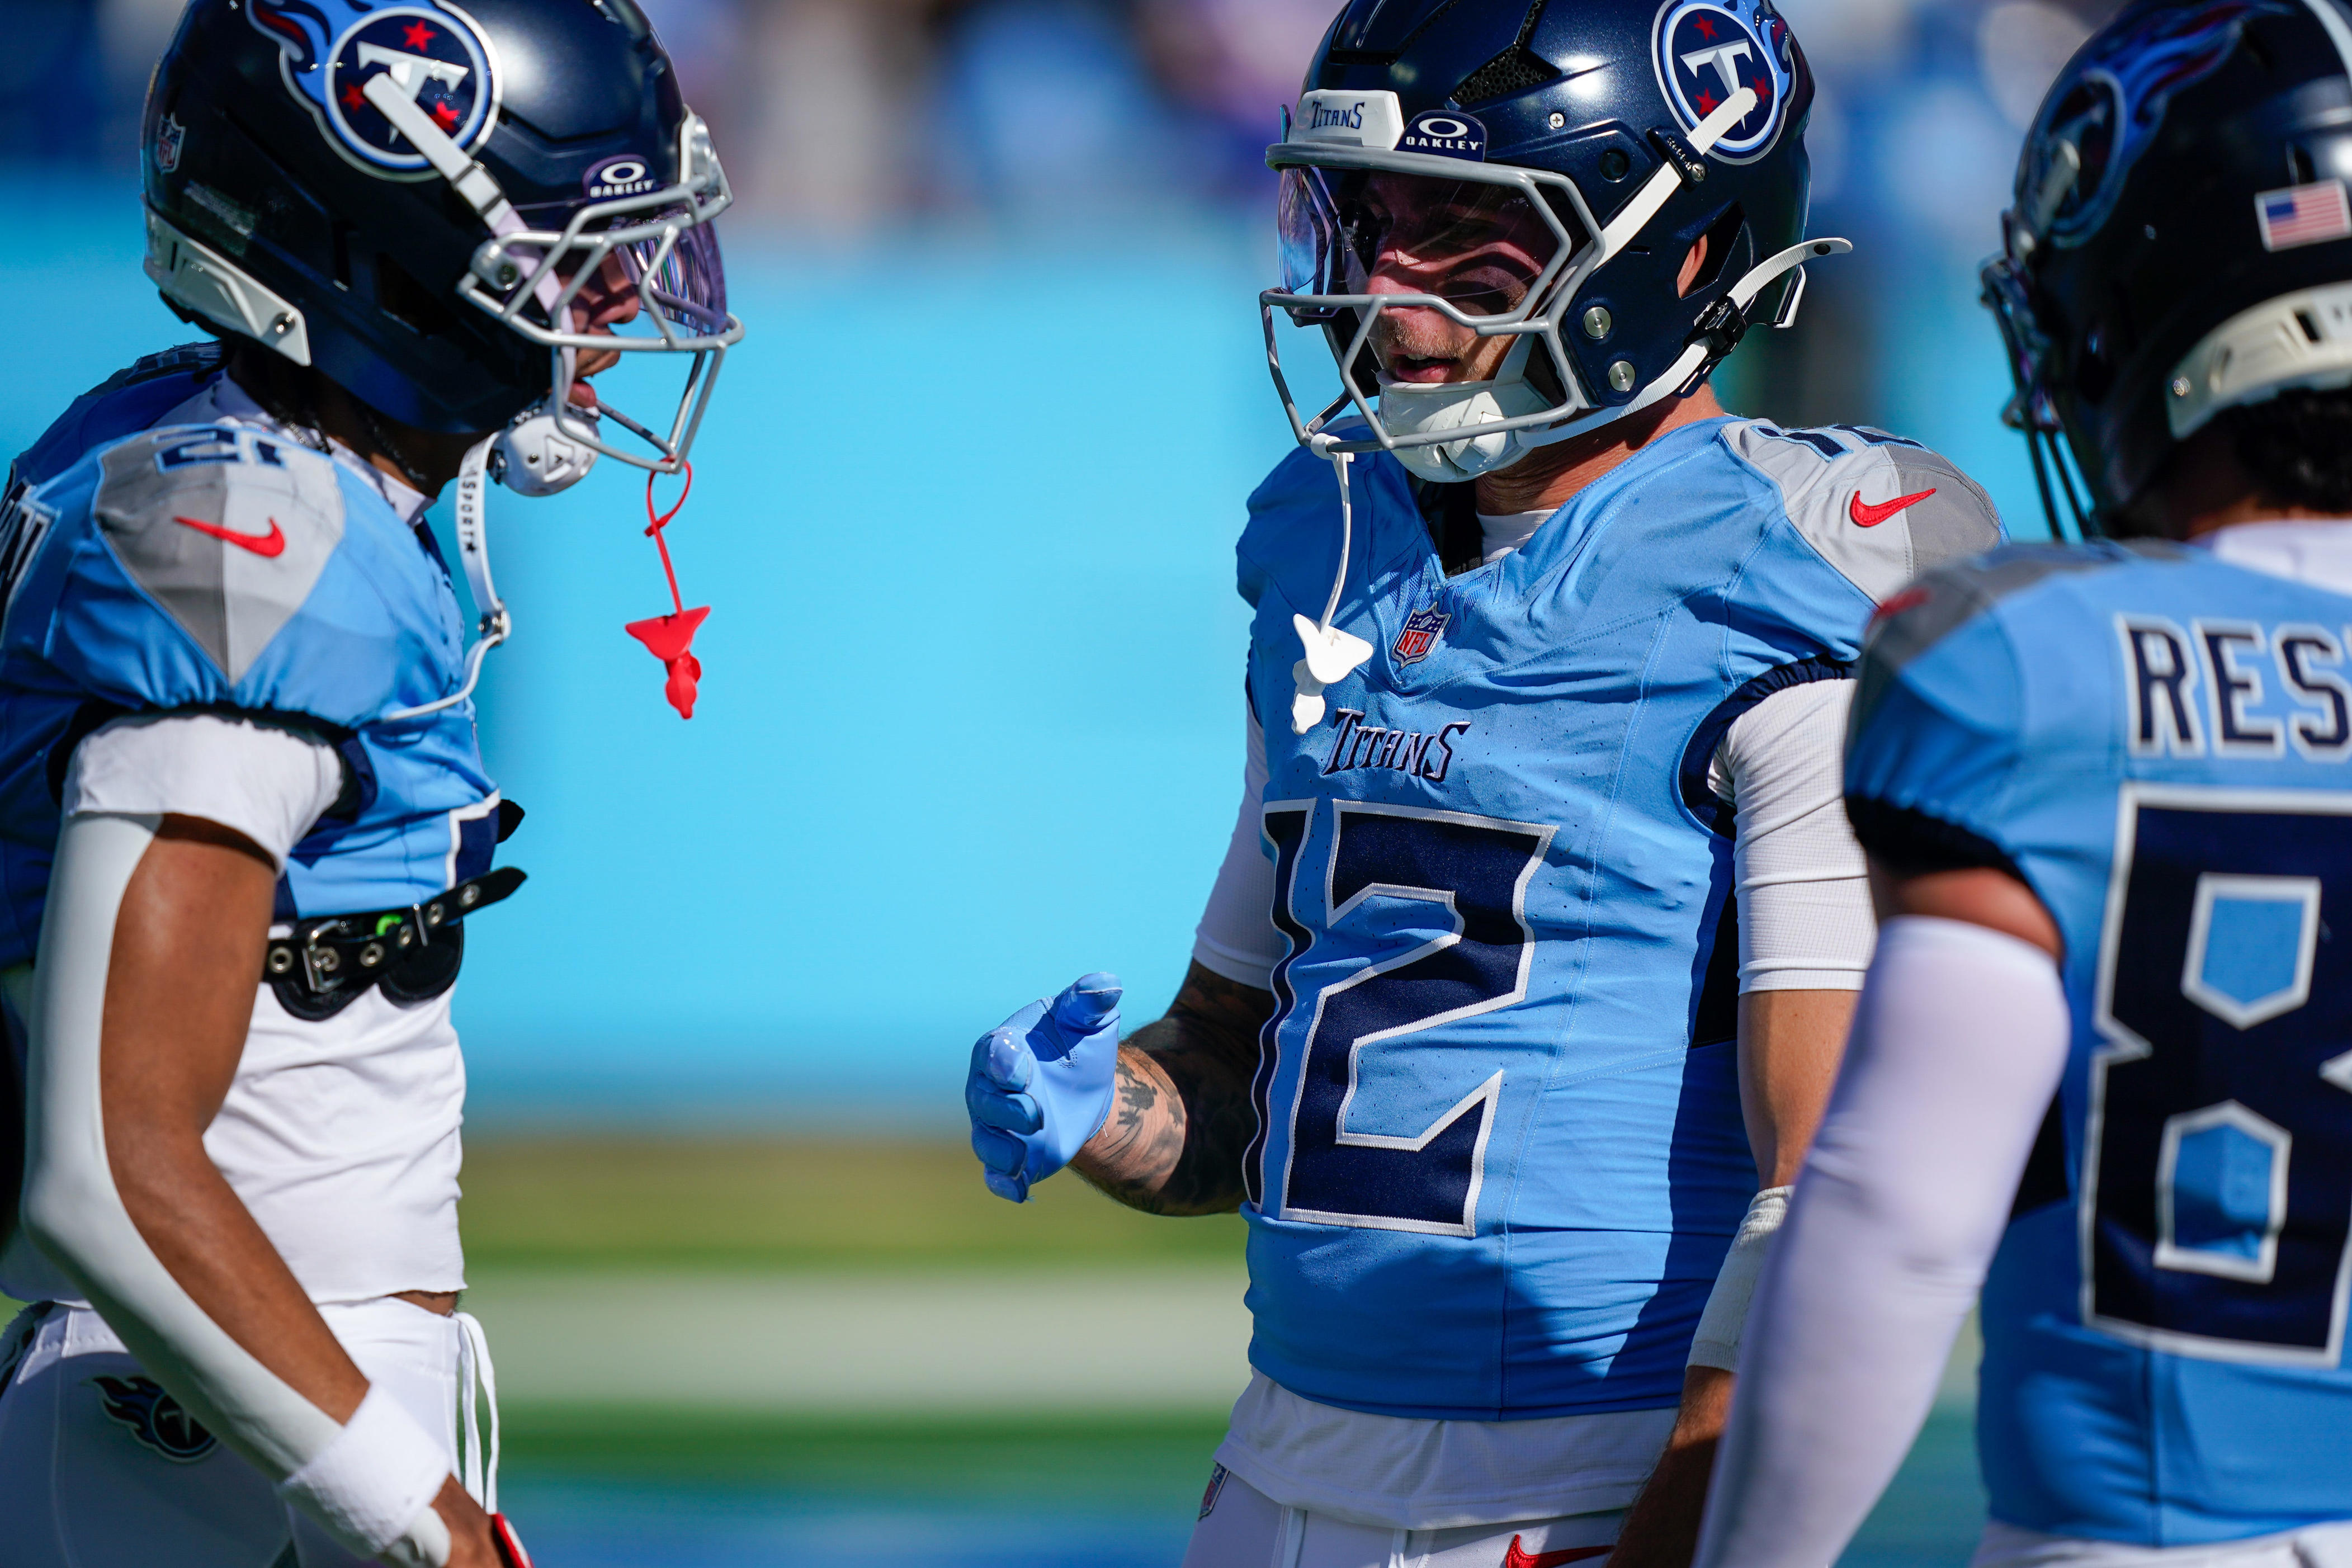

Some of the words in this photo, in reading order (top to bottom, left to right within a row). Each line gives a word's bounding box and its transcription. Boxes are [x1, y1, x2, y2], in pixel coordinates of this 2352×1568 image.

[1310, 100, 1365, 130] TITANS
[1406, 136, 1480, 150] OAKLEY
[589, 179, 654, 198] OAKLEY
[1398, 630, 1430, 655] NFL
[2114, 613, 2352, 763] RES
[1321, 707, 1472, 783] TITANS
[1242, 797, 1560, 1238] 12
